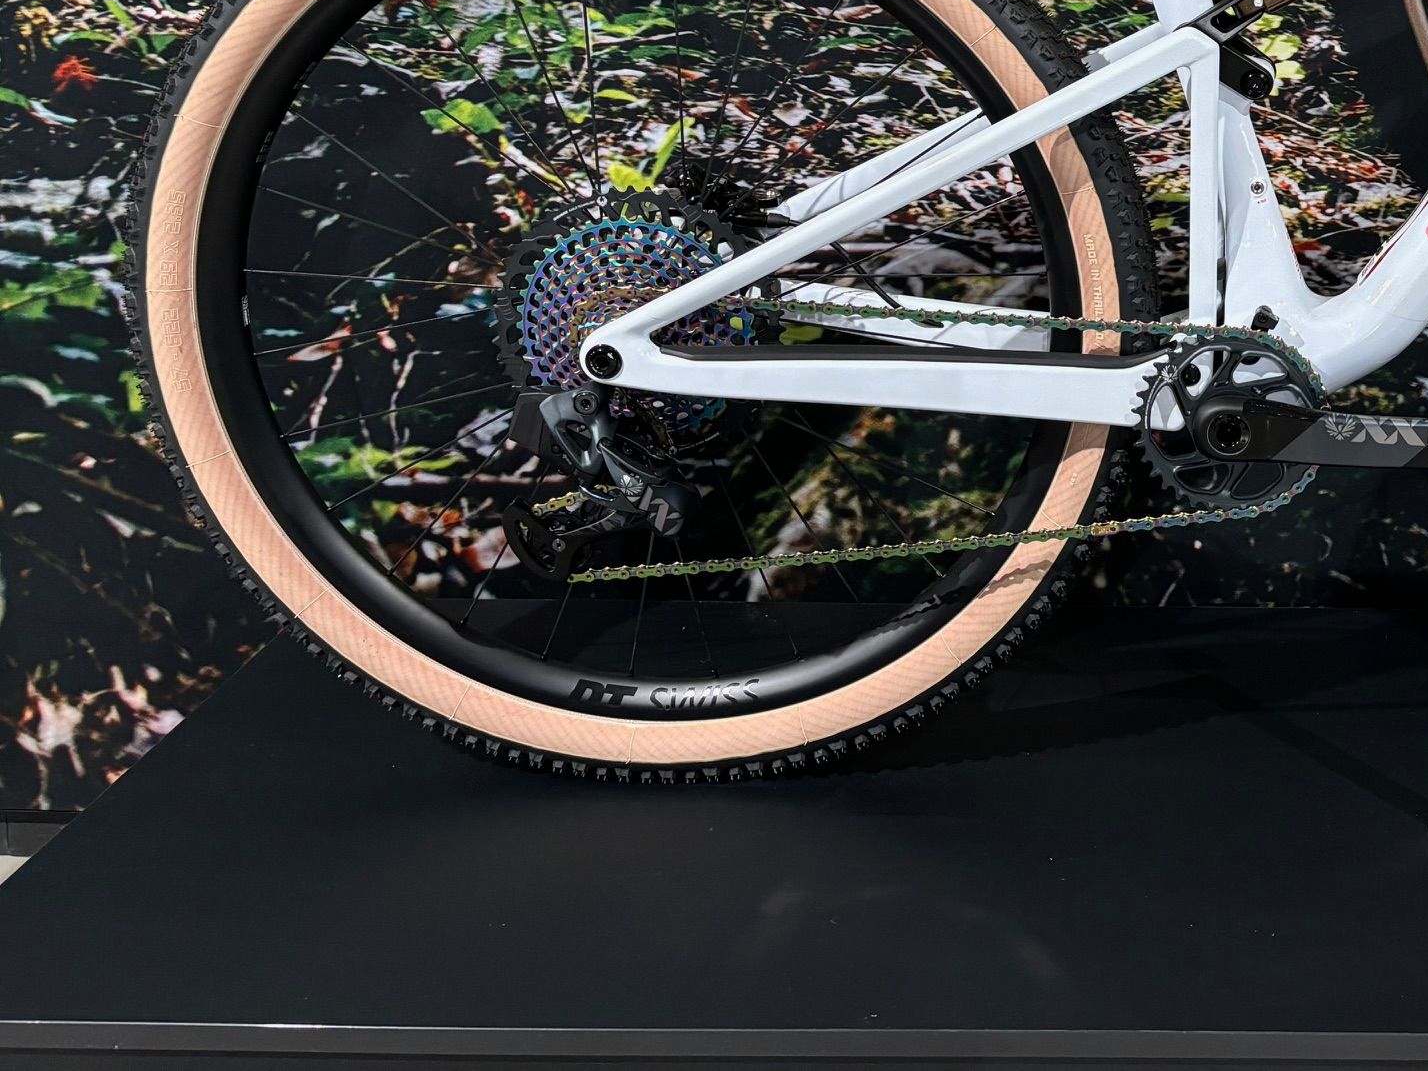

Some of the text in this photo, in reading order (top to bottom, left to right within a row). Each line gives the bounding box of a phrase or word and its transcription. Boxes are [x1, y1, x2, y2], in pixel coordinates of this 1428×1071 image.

[163, 188, 187, 234] 2.35
[160, 259, 178, 286] 29
[1092, 284, 1105, 340] THAILD
[568, 678, 760, 710] DT SWISS
